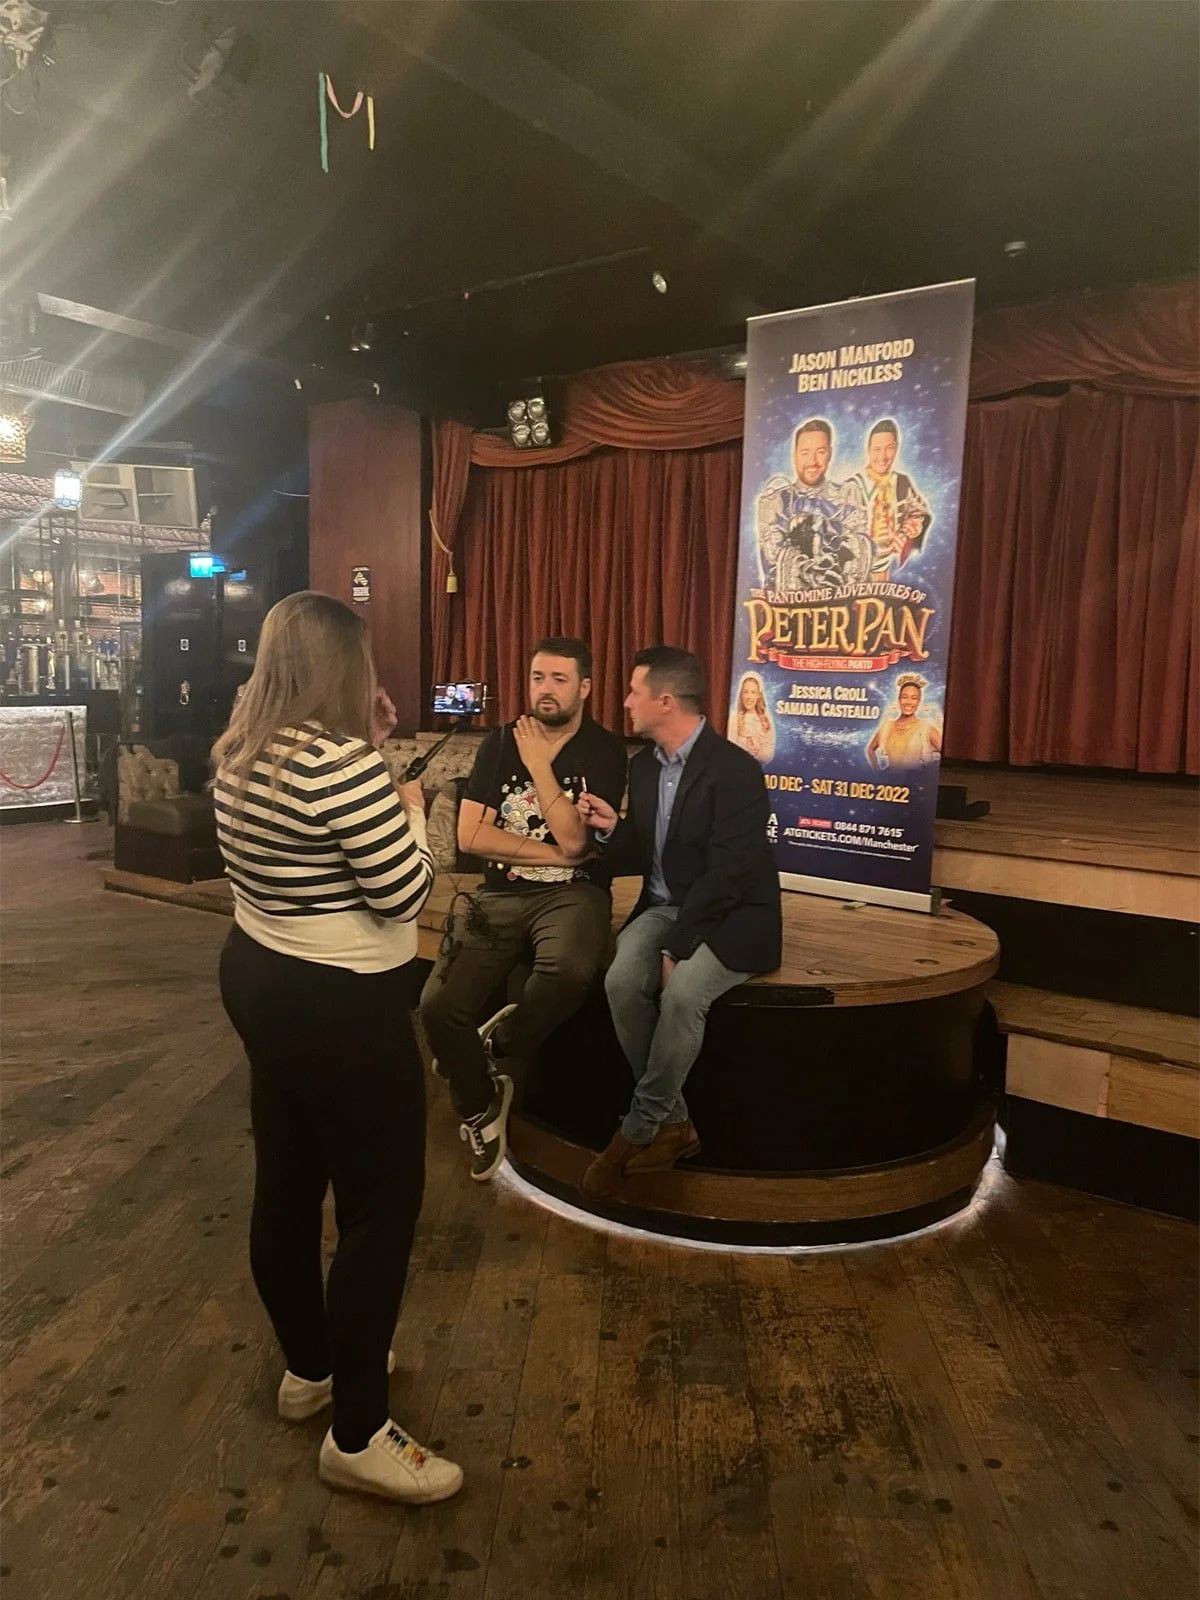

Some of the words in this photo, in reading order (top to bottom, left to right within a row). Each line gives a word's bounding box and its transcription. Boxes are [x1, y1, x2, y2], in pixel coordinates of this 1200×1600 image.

[788, 350, 837, 374] JASON
[839, 338, 915, 367] MANFORD
[797, 372, 829, 393] BEN
[830, 361, 903, 389] NICKLESS
[767, 587, 834, 604] PANTOMIME
[834, 582, 911, 600] ADVENTURES
[910, 589, 927, 604] OF
[743, 599, 855, 664] PETER
[852, 597, 936, 662] PAN
[788, 684, 832, 700] JESSICA
[833, 686, 868, 702] CROLL
[775, 700, 819, 716] SAMARA
[820, 702, 880, 720] CASTEALLO
[778, 776, 803, 792] DEC
[810, 778, 834, 795] SAT
[834, 780, 849, 797] 31
[850, 782, 875, 800] DEC
[875, 785, 910, 804] 2022
[833, 821, 858, 833] 0844
[858, 823, 876, 835] 871
